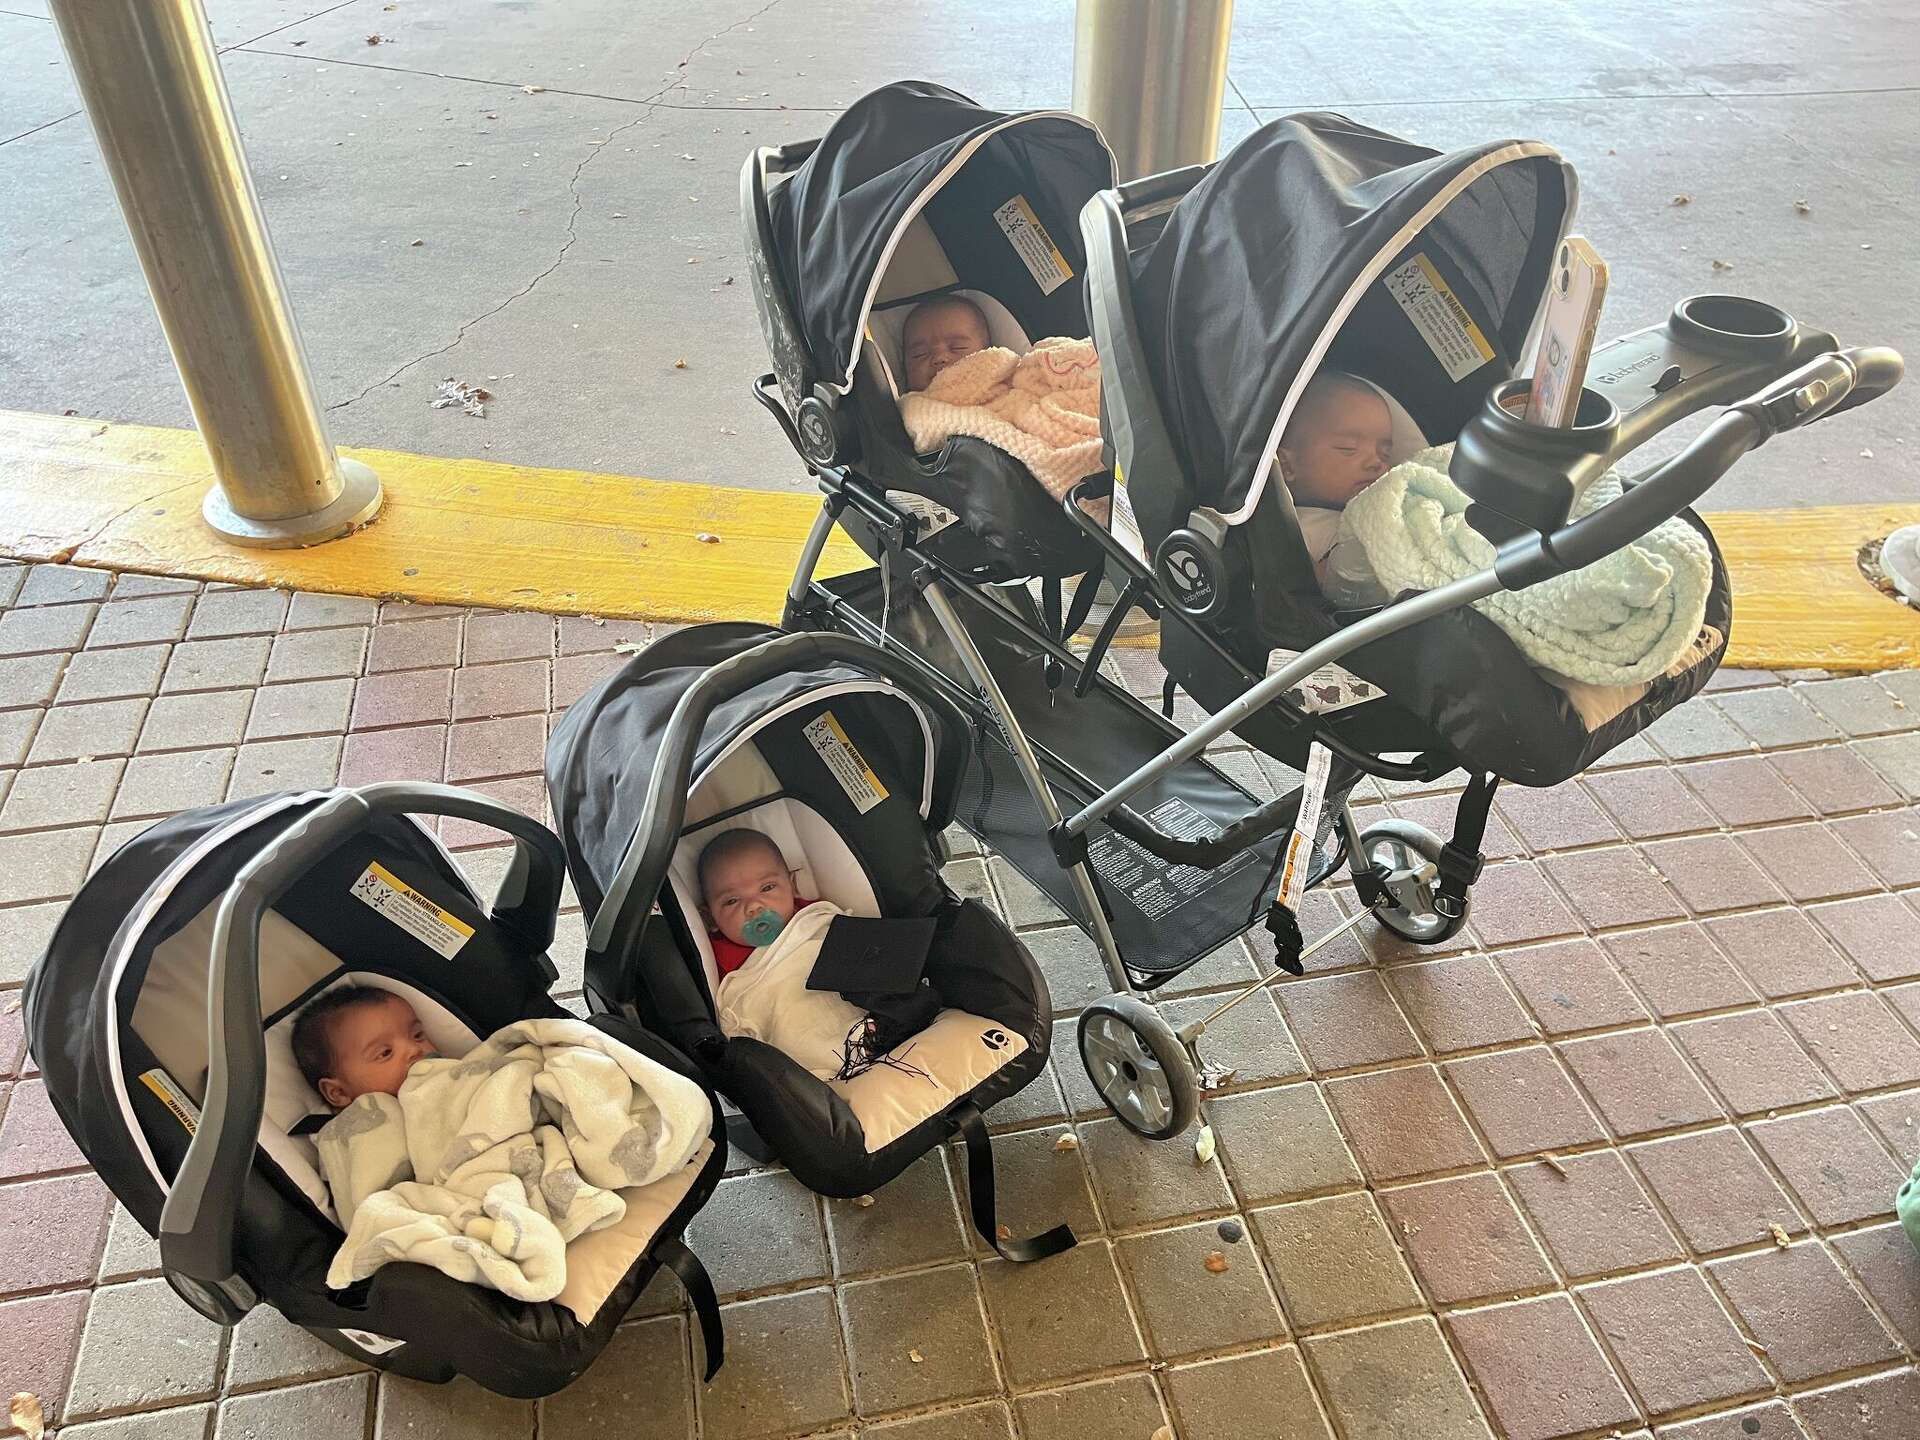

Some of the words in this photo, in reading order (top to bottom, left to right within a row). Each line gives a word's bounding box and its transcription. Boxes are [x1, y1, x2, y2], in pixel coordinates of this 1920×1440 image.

[1444, 294, 1471, 328] WARNING
[1182, 584, 1212, 603] babytrend
[986, 698, 1019, 757] babytrend
[846, 745, 869, 773] WARNING
[408, 891, 442, 917] WARNING
